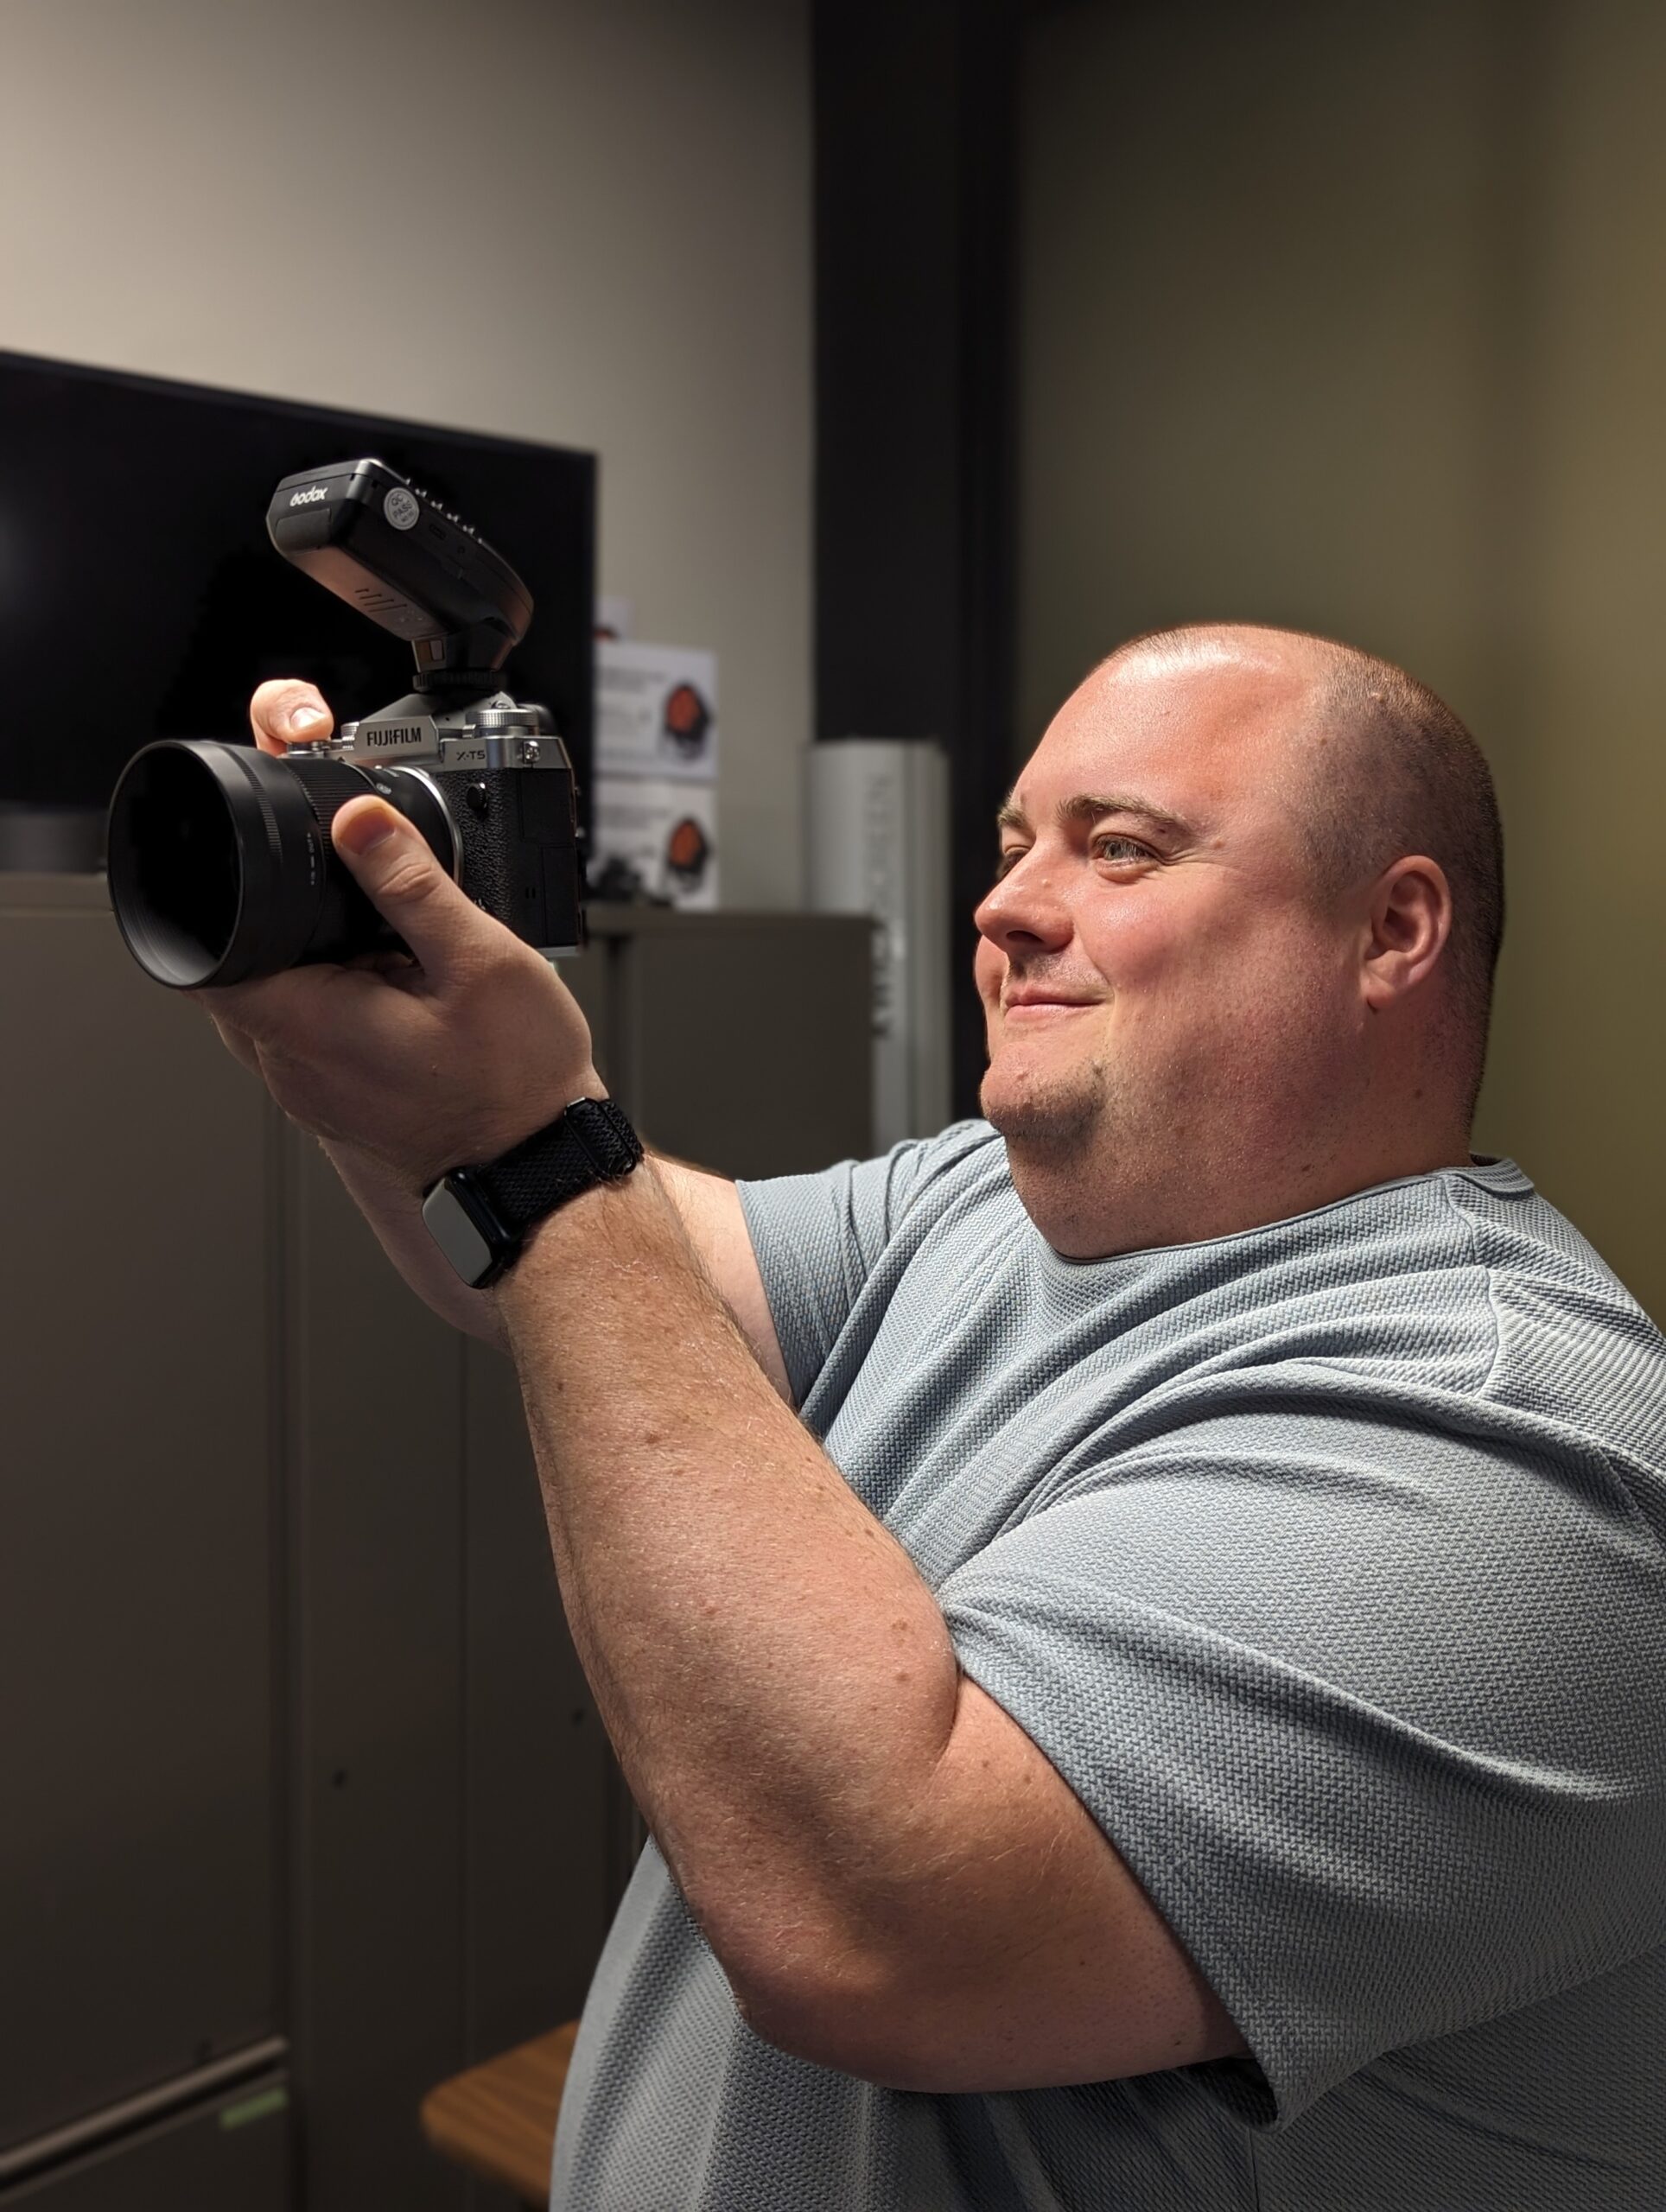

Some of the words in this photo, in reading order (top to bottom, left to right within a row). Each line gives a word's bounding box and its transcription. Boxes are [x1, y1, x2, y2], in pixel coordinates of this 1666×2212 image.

[289, 486, 328, 507] Godox
[366, 727, 422, 747] FUJIFILM
[456, 750, 486, 761] X-T5
